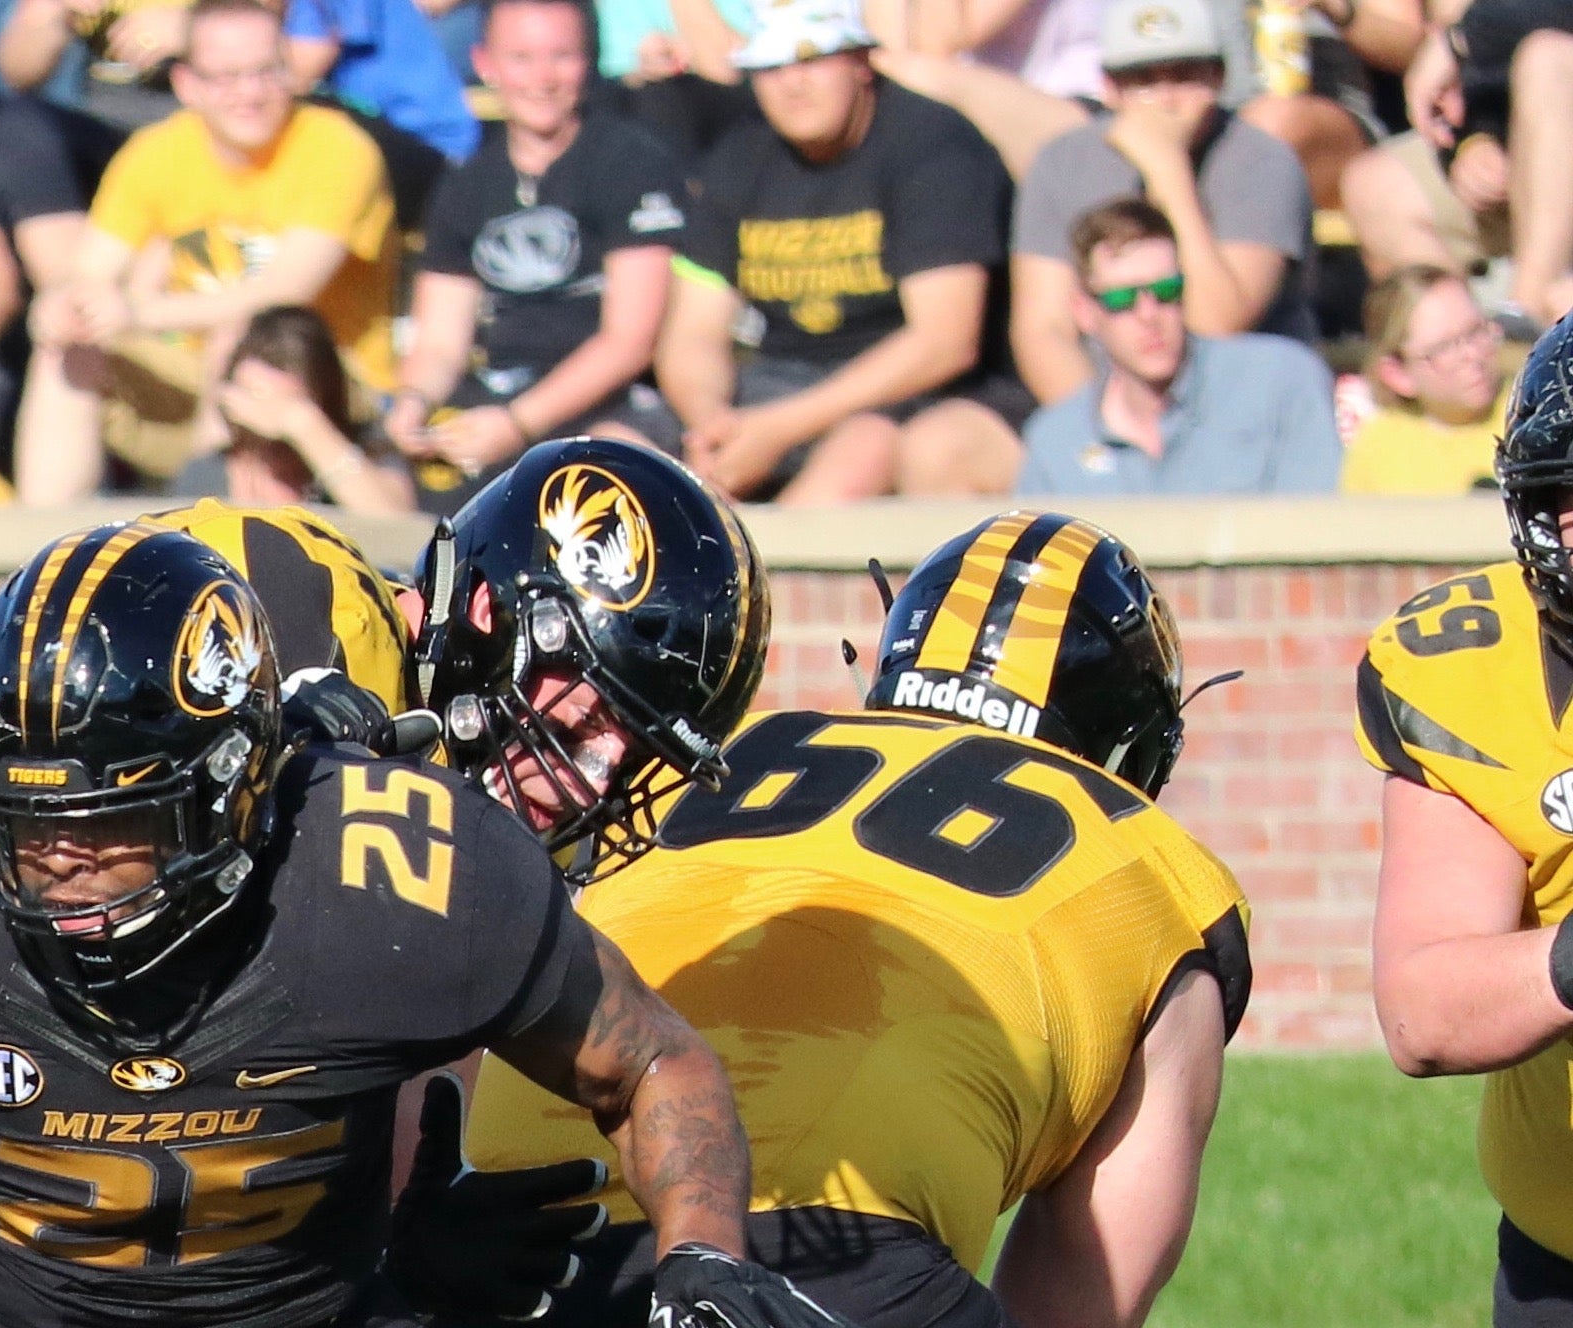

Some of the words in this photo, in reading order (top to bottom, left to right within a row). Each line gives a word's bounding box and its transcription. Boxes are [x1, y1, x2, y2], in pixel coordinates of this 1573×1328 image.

[893, 671, 1041, 738] Riddell
[671, 717, 719, 759] Riddell
[7, 766, 70, 787] TIGERS
[655, 710, 1153, 898] 66
[339, 763, 455, 919] 25
[41, 1107, 263, 1142] MIZZOU
